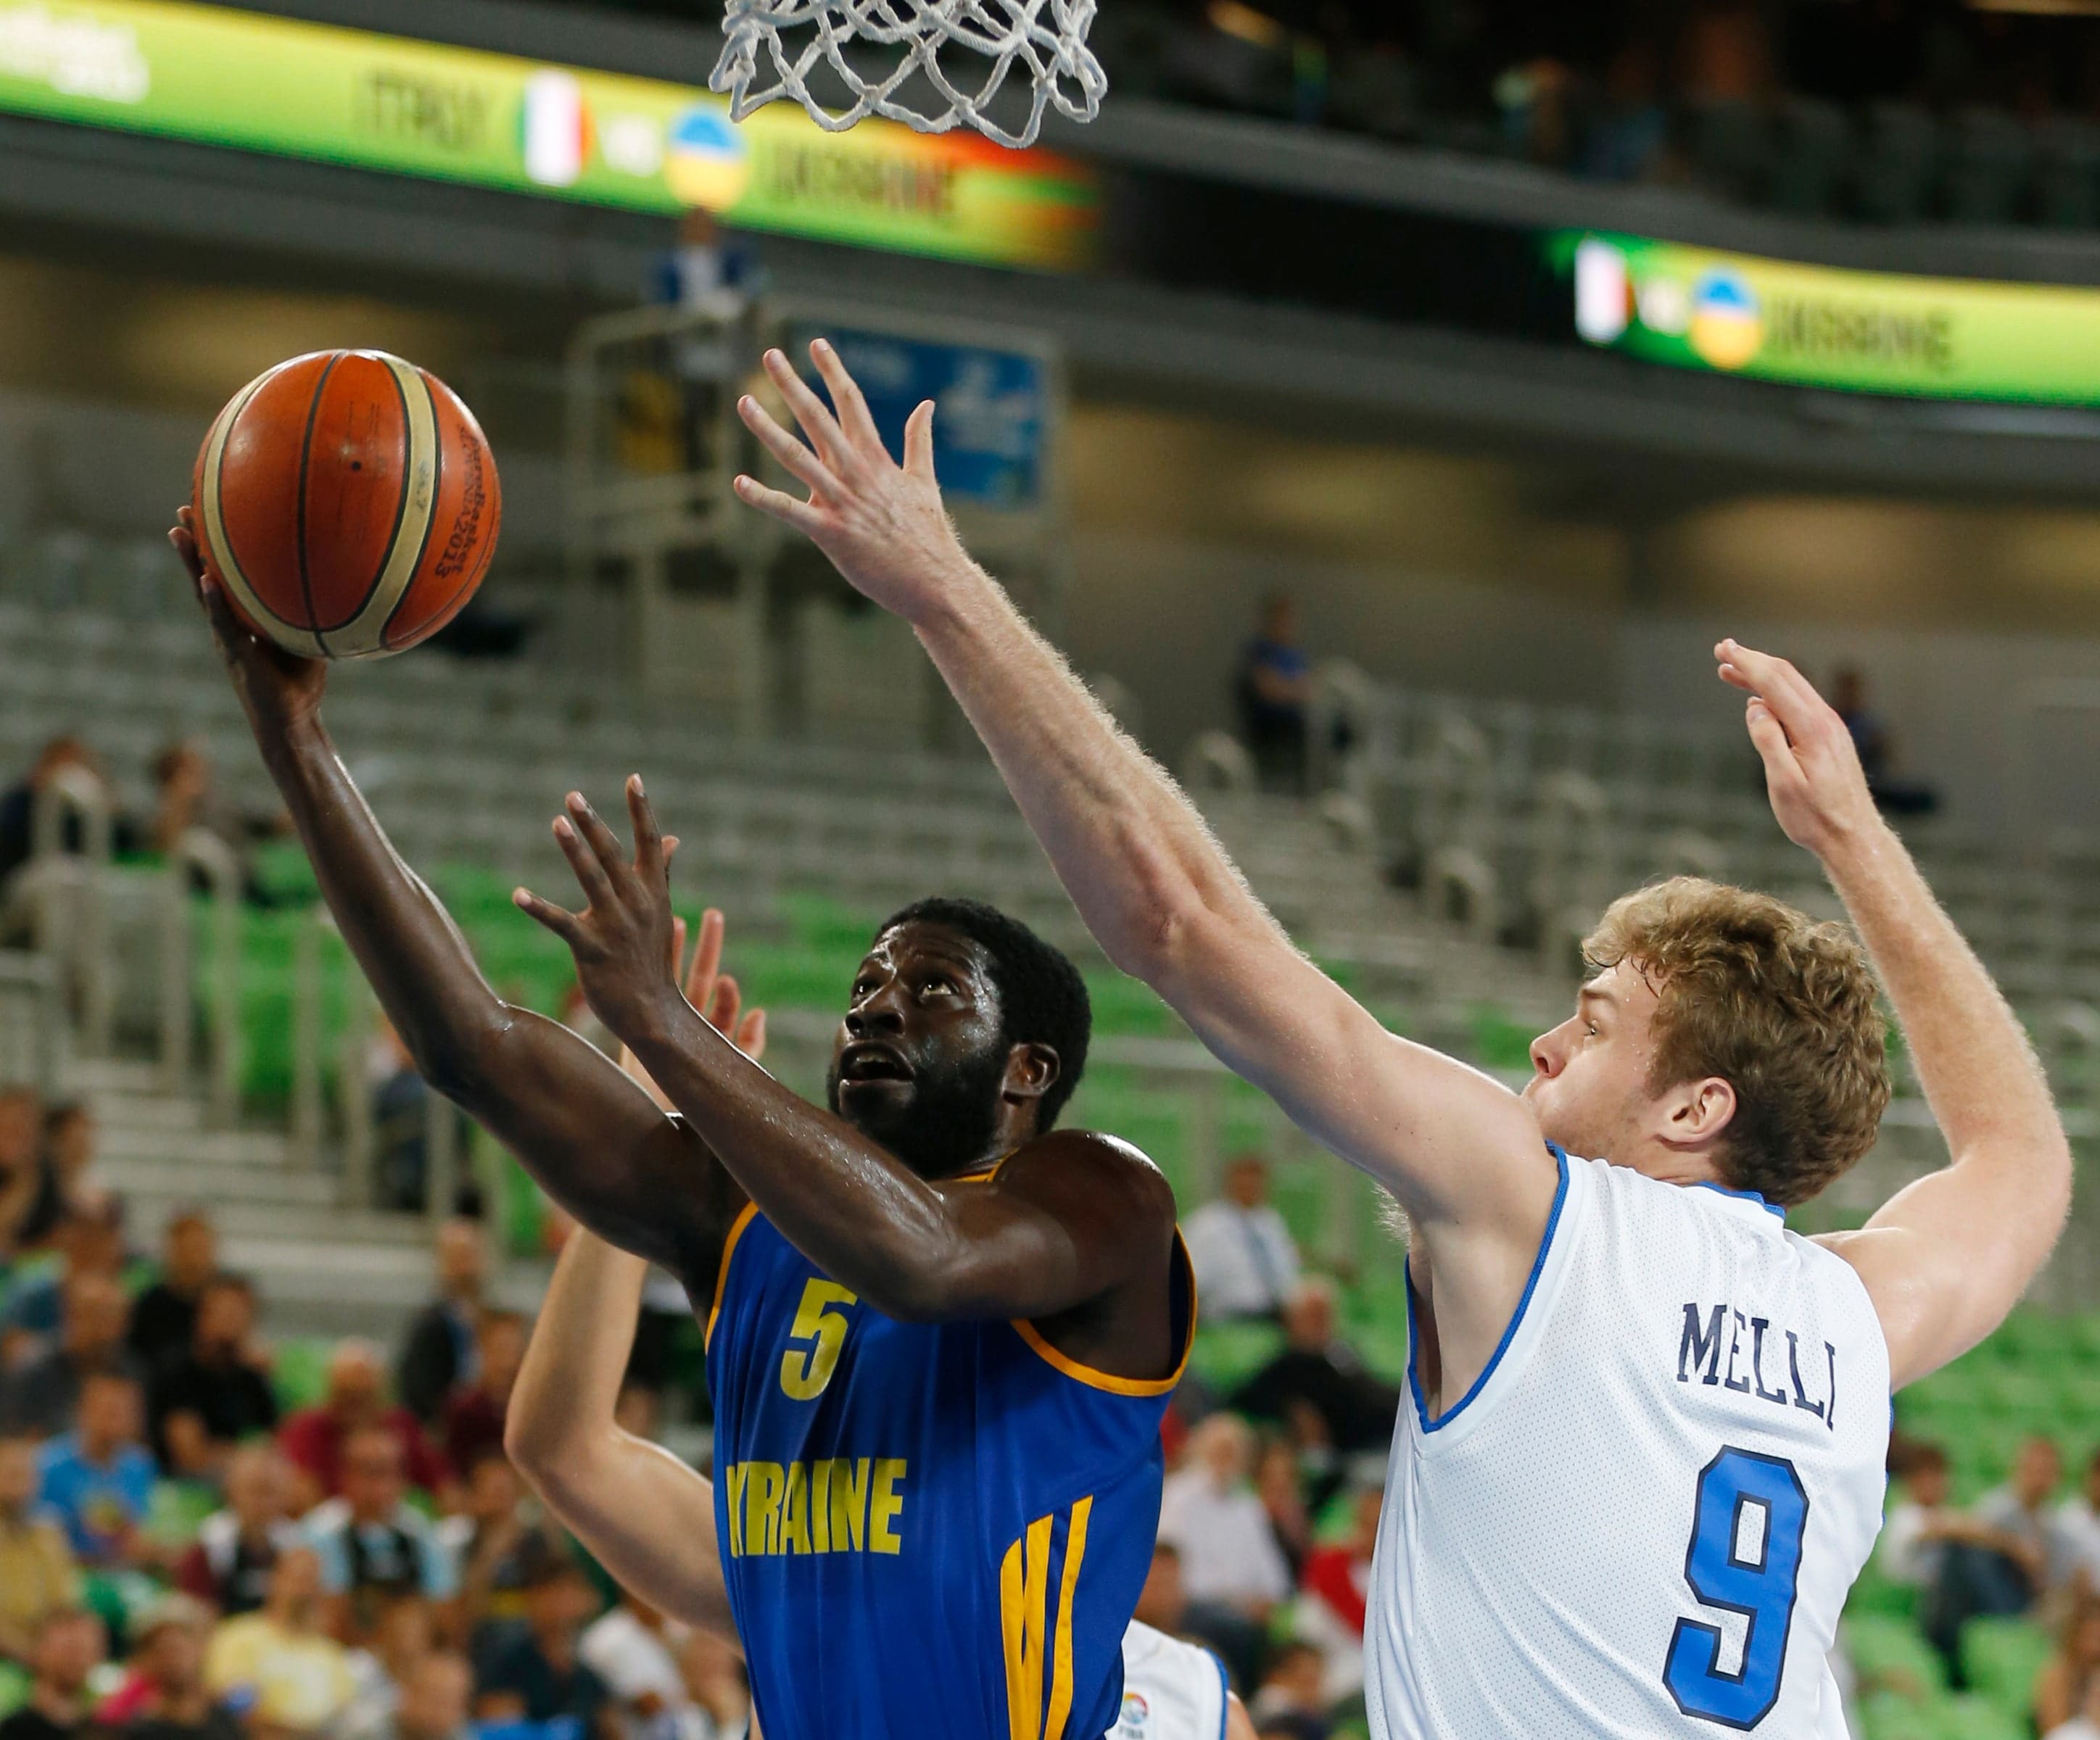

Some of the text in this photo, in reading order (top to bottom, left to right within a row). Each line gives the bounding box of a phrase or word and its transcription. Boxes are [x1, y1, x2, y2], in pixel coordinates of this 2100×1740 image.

[435, 515, 467, 579] 2013
[780, 1277, 857, 1401] 5
[1677, 1303, 1835, 1430] MELLI
[727, 1457, 906, 1558] KRAINE
[1662, 1444, 1809, 1731] 9
